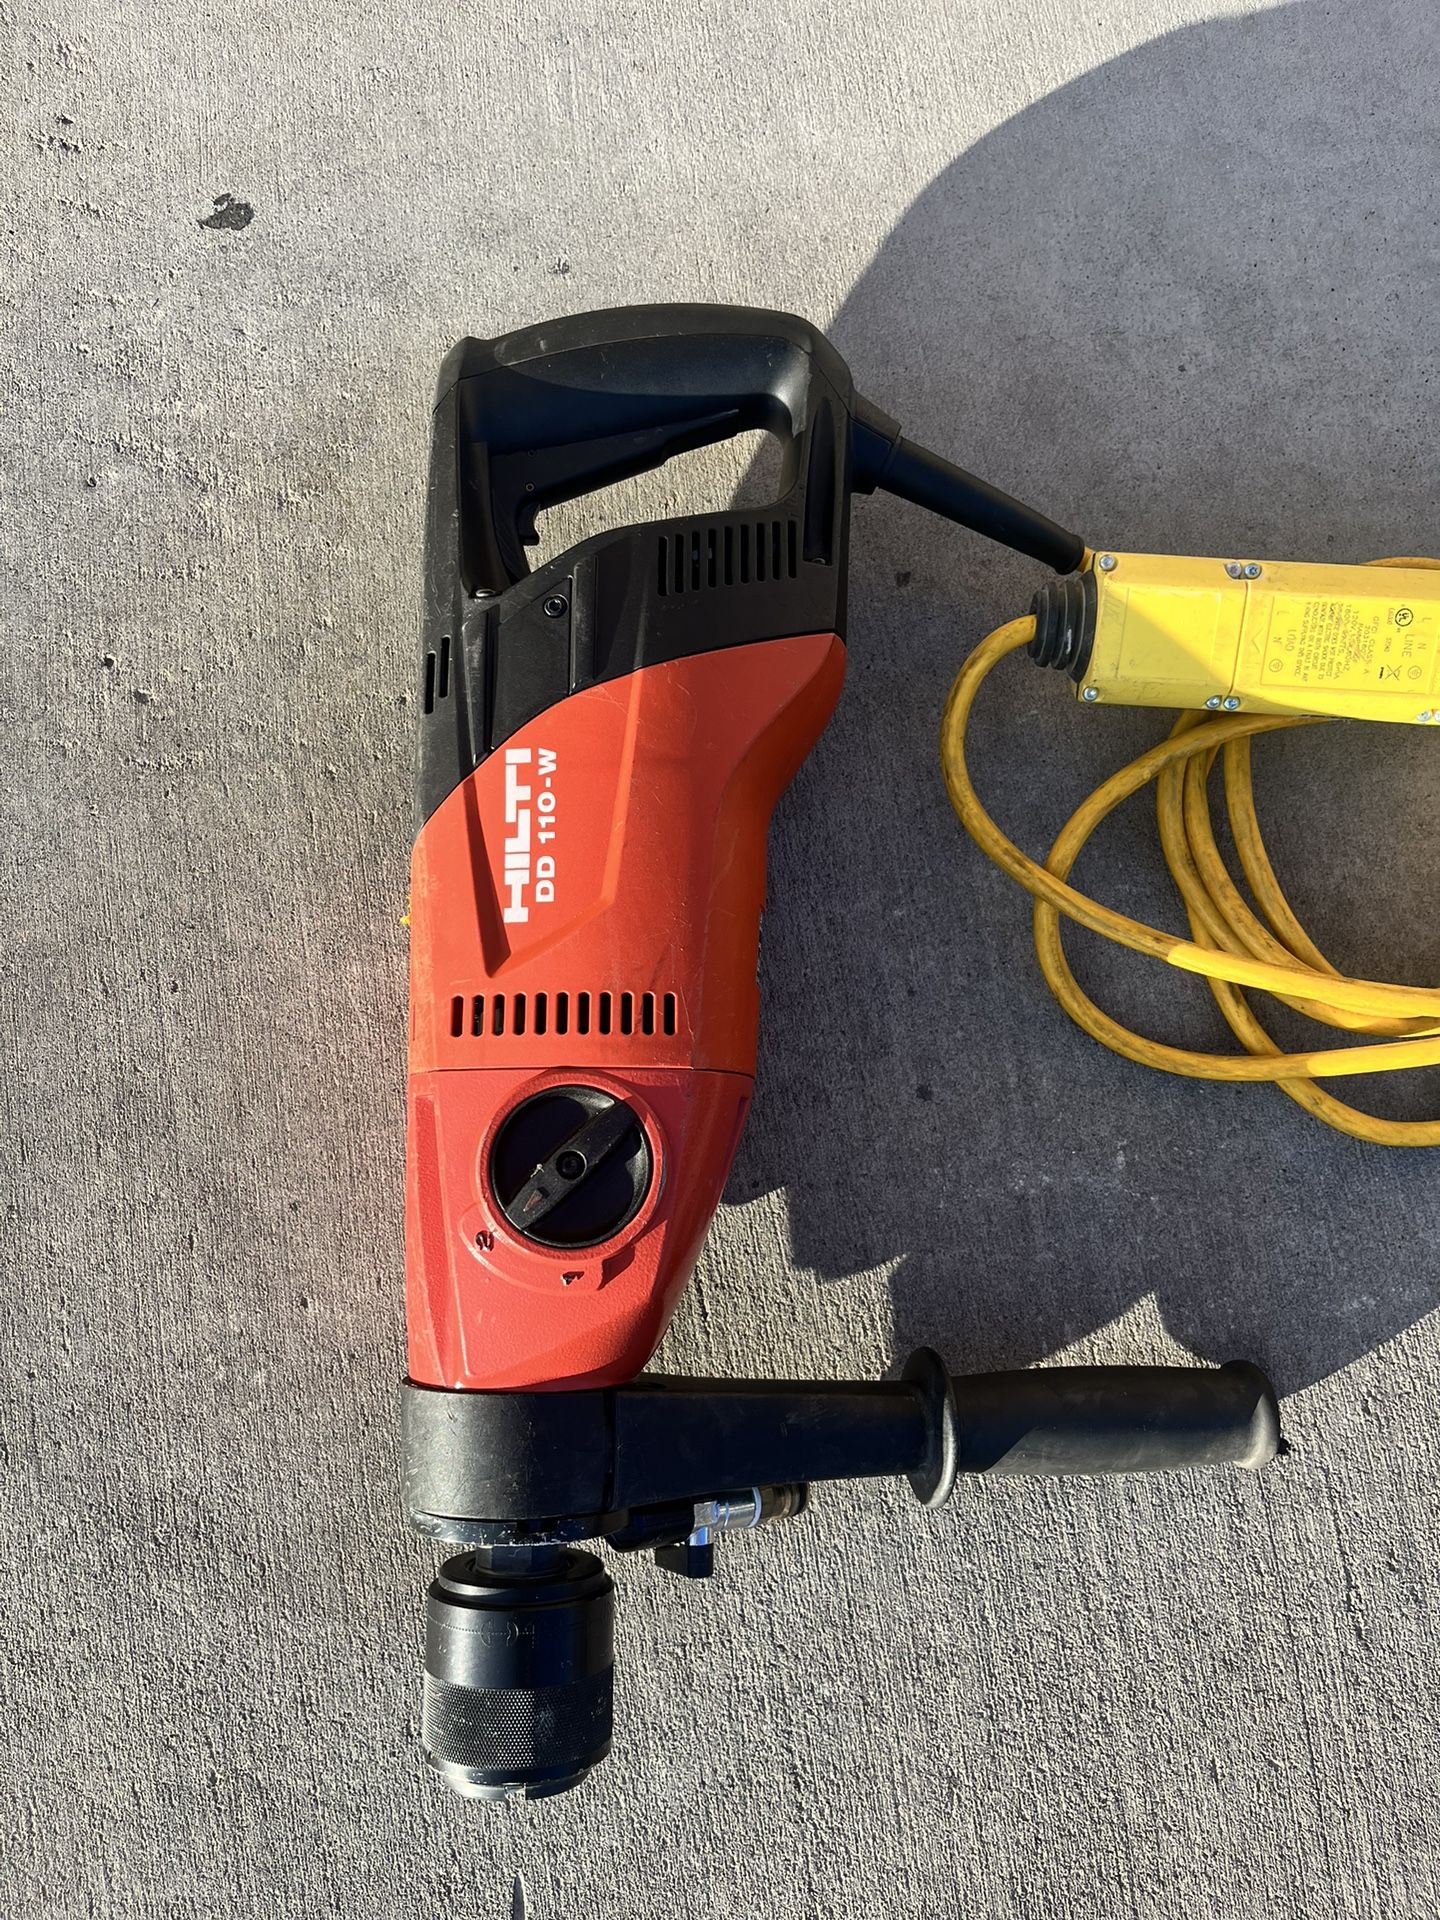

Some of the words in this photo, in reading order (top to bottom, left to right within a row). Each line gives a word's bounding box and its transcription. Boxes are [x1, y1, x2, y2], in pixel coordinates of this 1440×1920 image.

[1285, 629, 1297, 652] LOAD
[1401, 633, 1414, 658] LINE
[537, 748, 557, 844] 110-W
[503, 748, 531, 923] HILTI
[536, 855, 556, 903] DD
